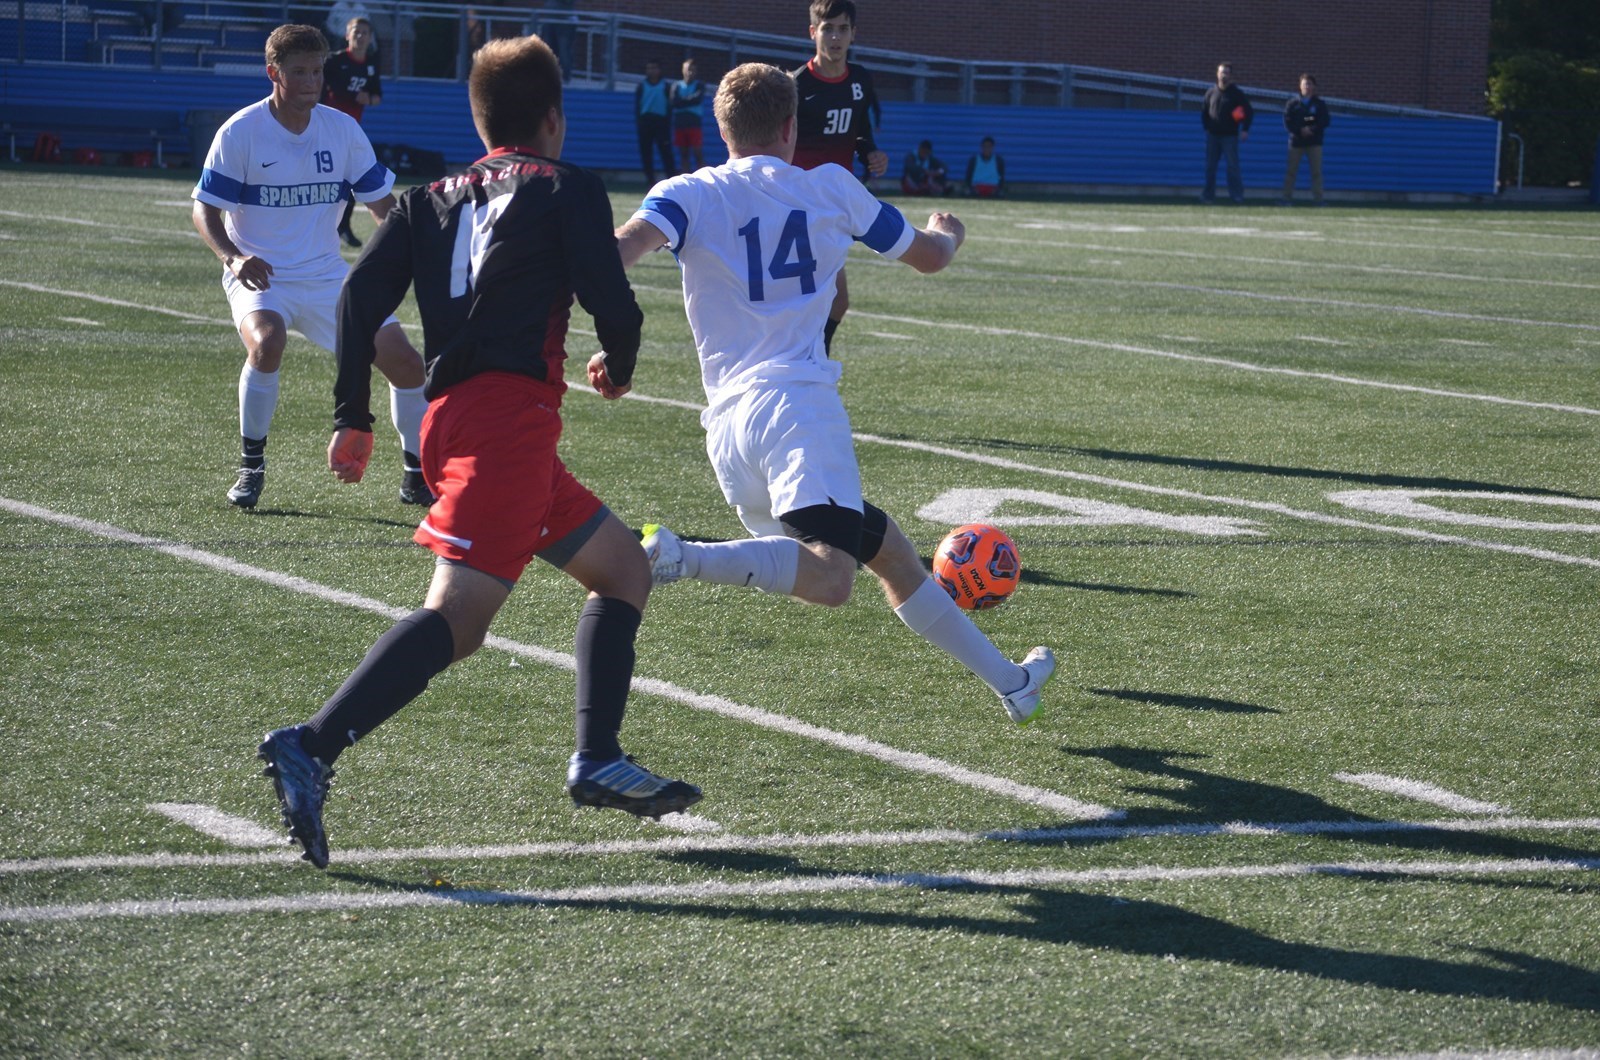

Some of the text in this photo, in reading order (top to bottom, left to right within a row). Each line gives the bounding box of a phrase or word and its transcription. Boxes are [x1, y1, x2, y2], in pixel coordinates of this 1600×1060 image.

[851, 82, 864, 101] B
[823, 108, 853, 135] 30
[314, 150, 334, 174] 19
[259, 183, 340, 207] SPARTANS
[738, 209, 817, 302] 14
[958, 571, 974, 599] Wilson
[969, 568, 987, 591] NCAA
